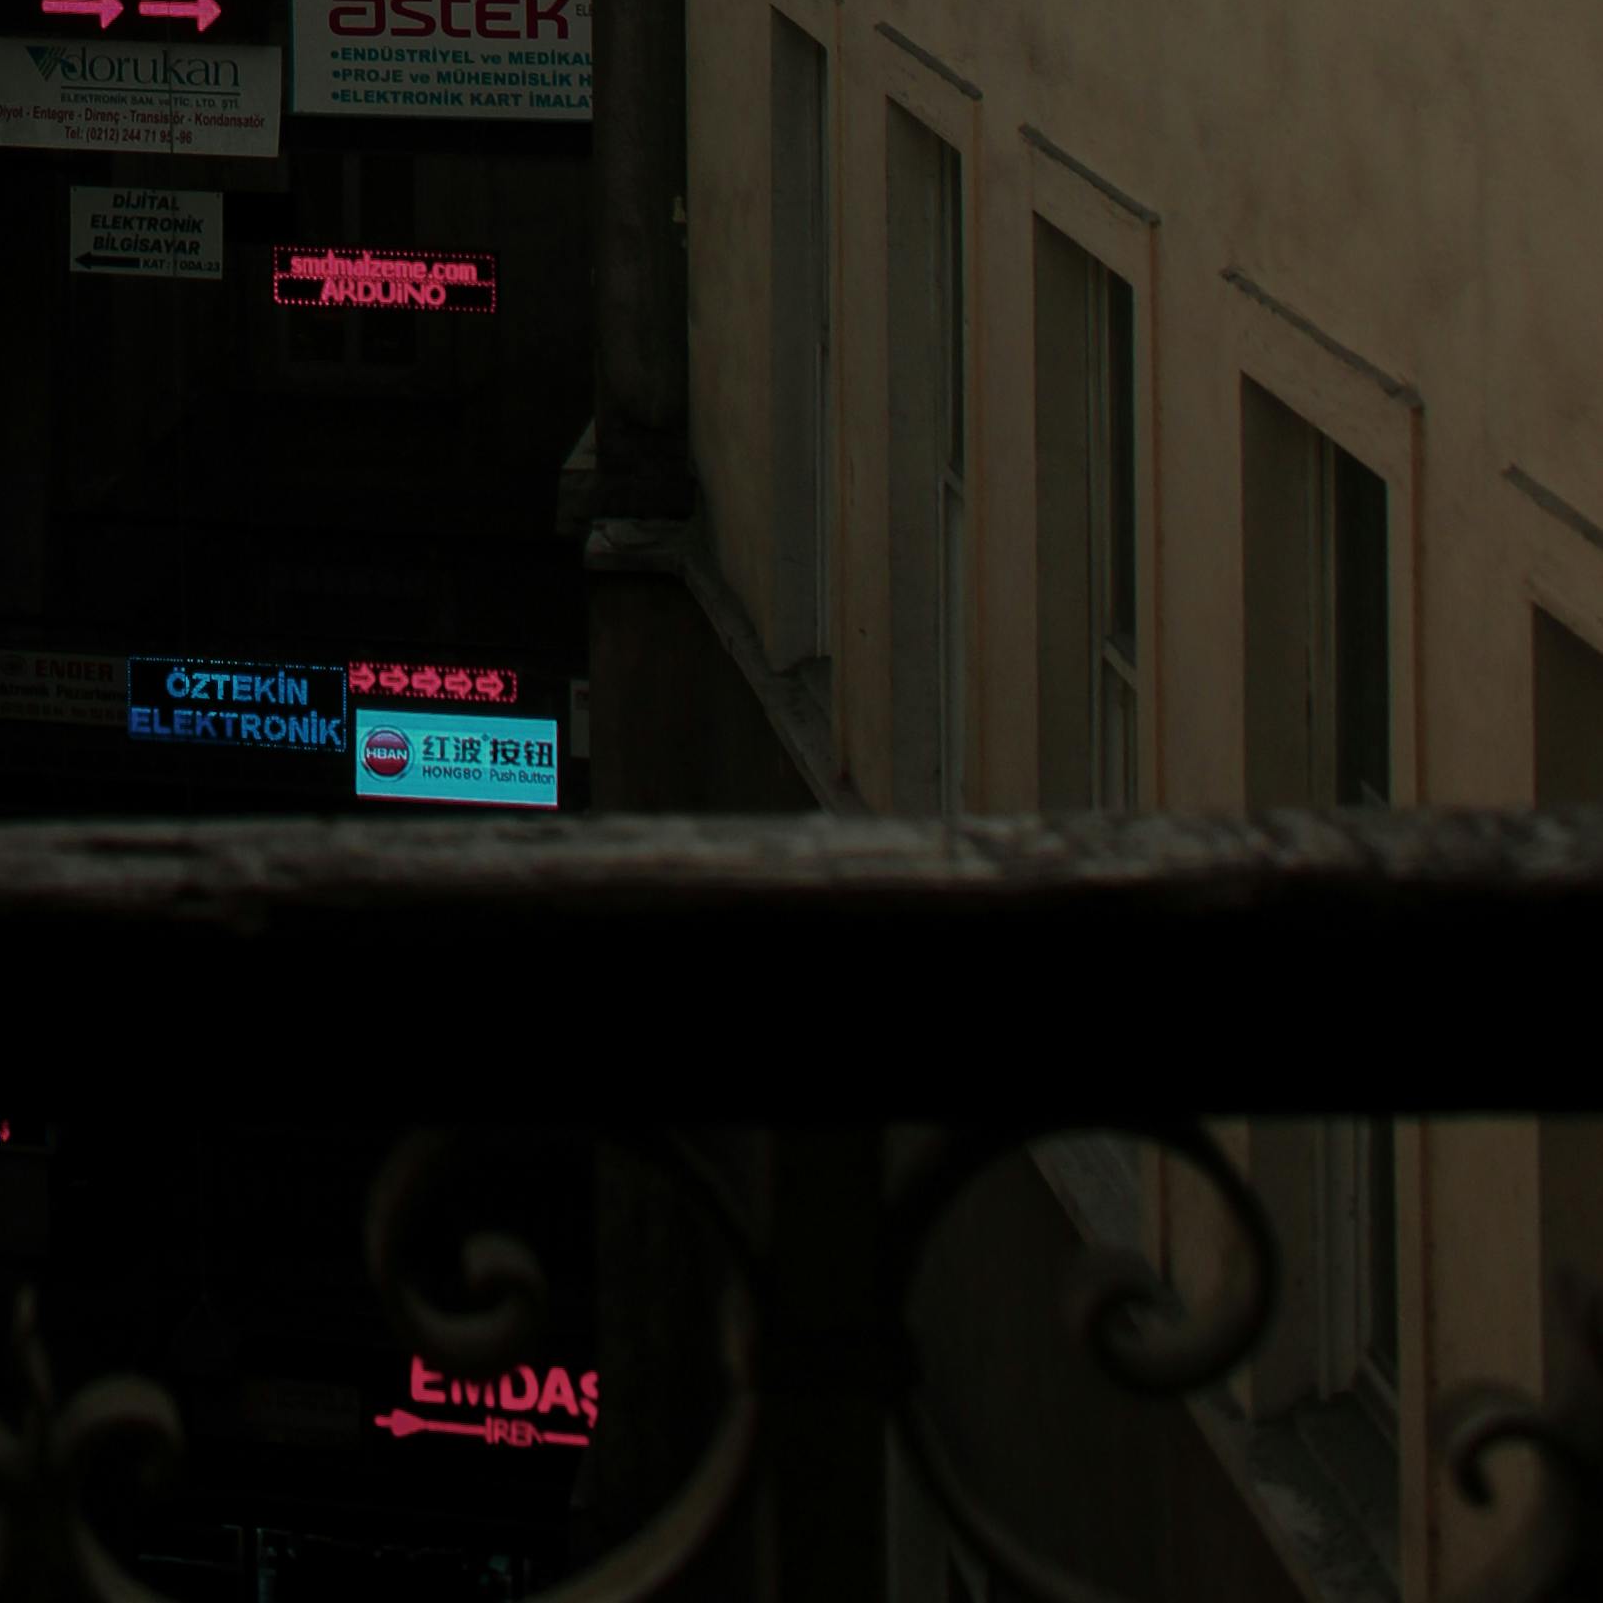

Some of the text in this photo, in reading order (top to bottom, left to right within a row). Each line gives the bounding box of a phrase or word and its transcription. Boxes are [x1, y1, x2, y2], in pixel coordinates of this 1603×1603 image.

[341, 45, 475, 65] ENDÜSTRİYEL
[481, 55, 502, 65] ve
[60, 46, 240, 88] dorukan
[341, 69, 404, 84] PROJE
[410, 74, 431, 84] ve
[437, 68, 572, 87] MÜHENDİSLİK
[341, 86, 463, 106] ELEKTRONİK
[470, 92, 522, 107] KART
[33, 105, 75, 123] Entegre
[84, 107, 120, 124] Direnç
[194, 112, 266, 129] Kondansatör
[86, 127, 120, 143] (0212)
[122, 128, 142, 142] 244
[145, 129, 157, 143] 71
[113, 189, 181, 211] DİJİTAL
[91, 213, 205, 233] ELEKTRONİK
[93, 232, 201, 255] BİLGİSAYAR
[290, 249, 478, 282] smdmalzeme.com
[166, 666, 309, 706] ÖZTEKİN
[130, 707, 343, 746] ELEKTRONİK
[366, 747, 408, 761] HBAN
[422, 766, 556, 785] HONGBO Push Button
